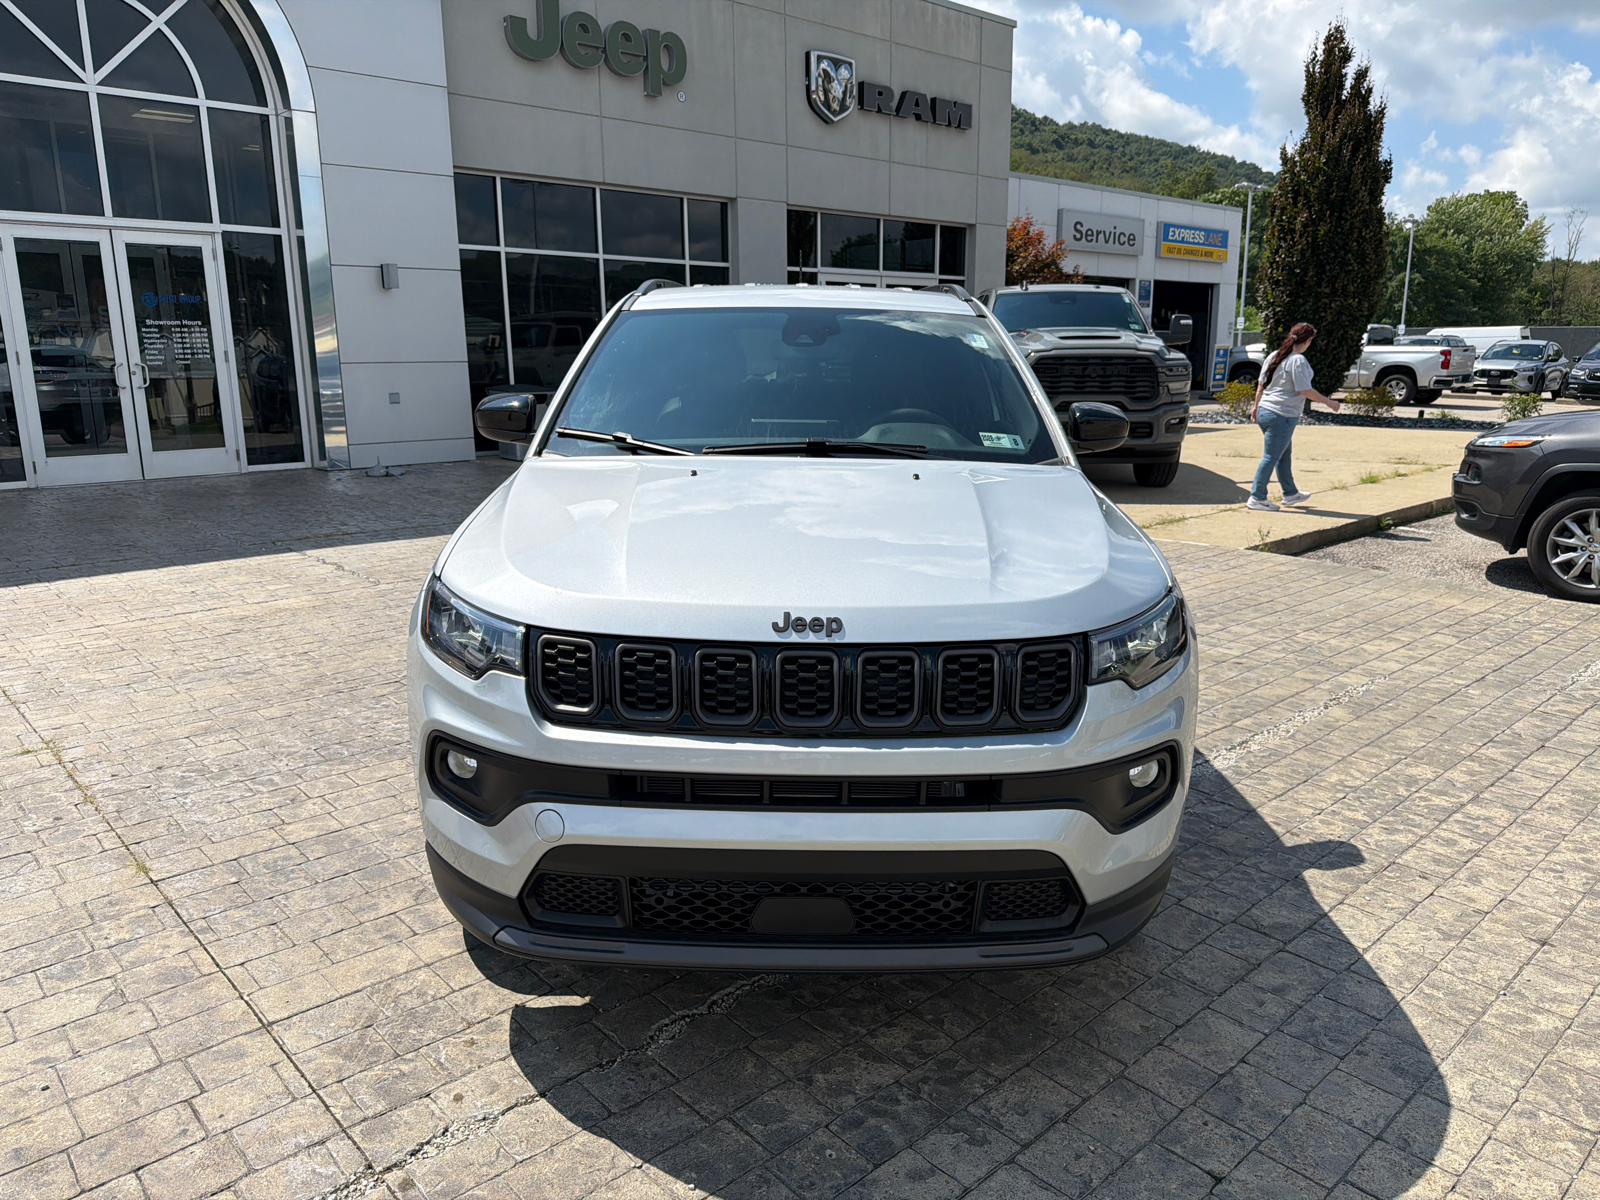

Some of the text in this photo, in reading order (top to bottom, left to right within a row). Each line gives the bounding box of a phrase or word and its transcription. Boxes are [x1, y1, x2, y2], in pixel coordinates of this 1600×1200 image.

[503, 0, 688, 98] Jeep
[858, 81, 973, 131] RAM
[1072, 220, 1137, 247] Service
[1183, 248, 1200, 257] CHANGES
[160, 294, 177, 303] AUTO
[179, 294, 201, 304] GROUP
[771, 611, 843, 638] Jeep
